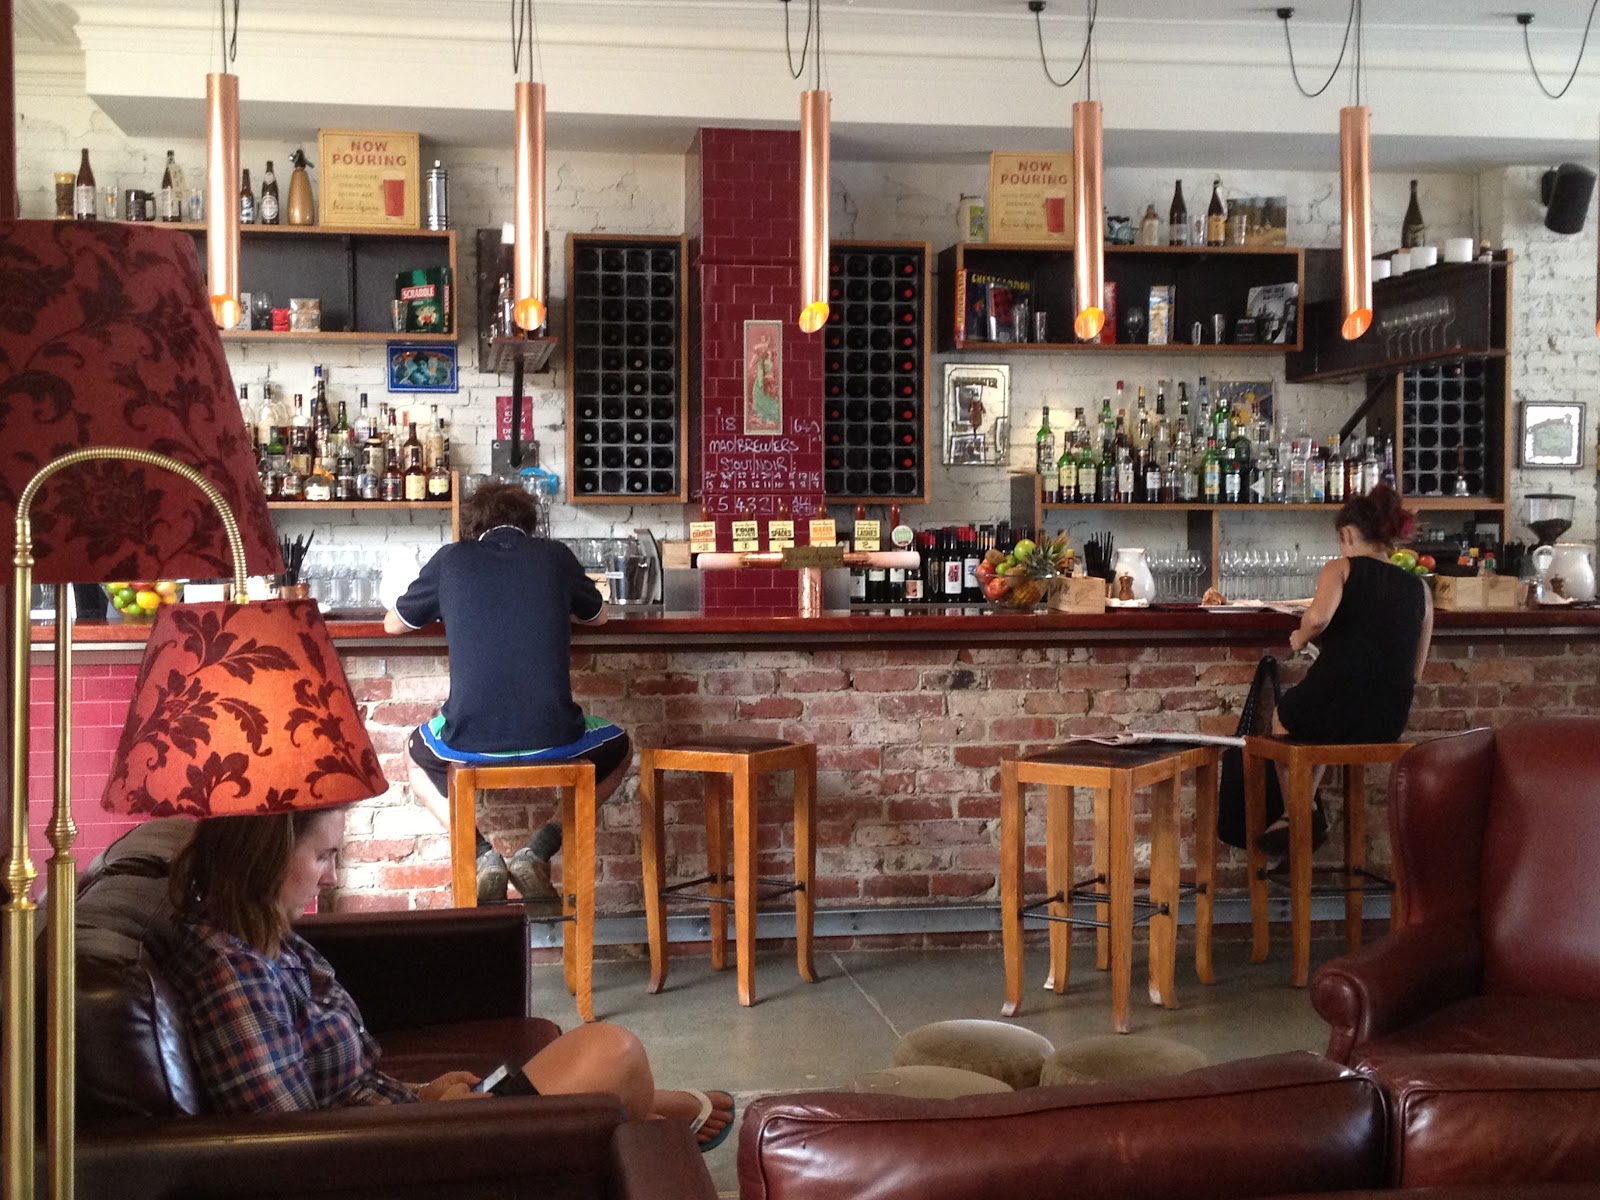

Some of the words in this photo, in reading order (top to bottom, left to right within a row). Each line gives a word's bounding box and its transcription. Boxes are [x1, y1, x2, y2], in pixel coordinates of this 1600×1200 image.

[351, 141, 388, 152] NOW
[332, 154, 407, 166] POURING
[1018, 161, 1052, 172] NOW
[1000, 174, 1068, 185] POURING
[402, 287, 435, 300] SCRABBLE
[709, 440, 735, 453] MAD
[737, 438, 799, 453] BREWERS
[720, 457, 753, 471] STOUT
[717, 496, 729, 511] 5
[736, 497, 745, 512] 4
[758, 497, 771, 512] 2
[770, 529, 792, 537] SPADES
